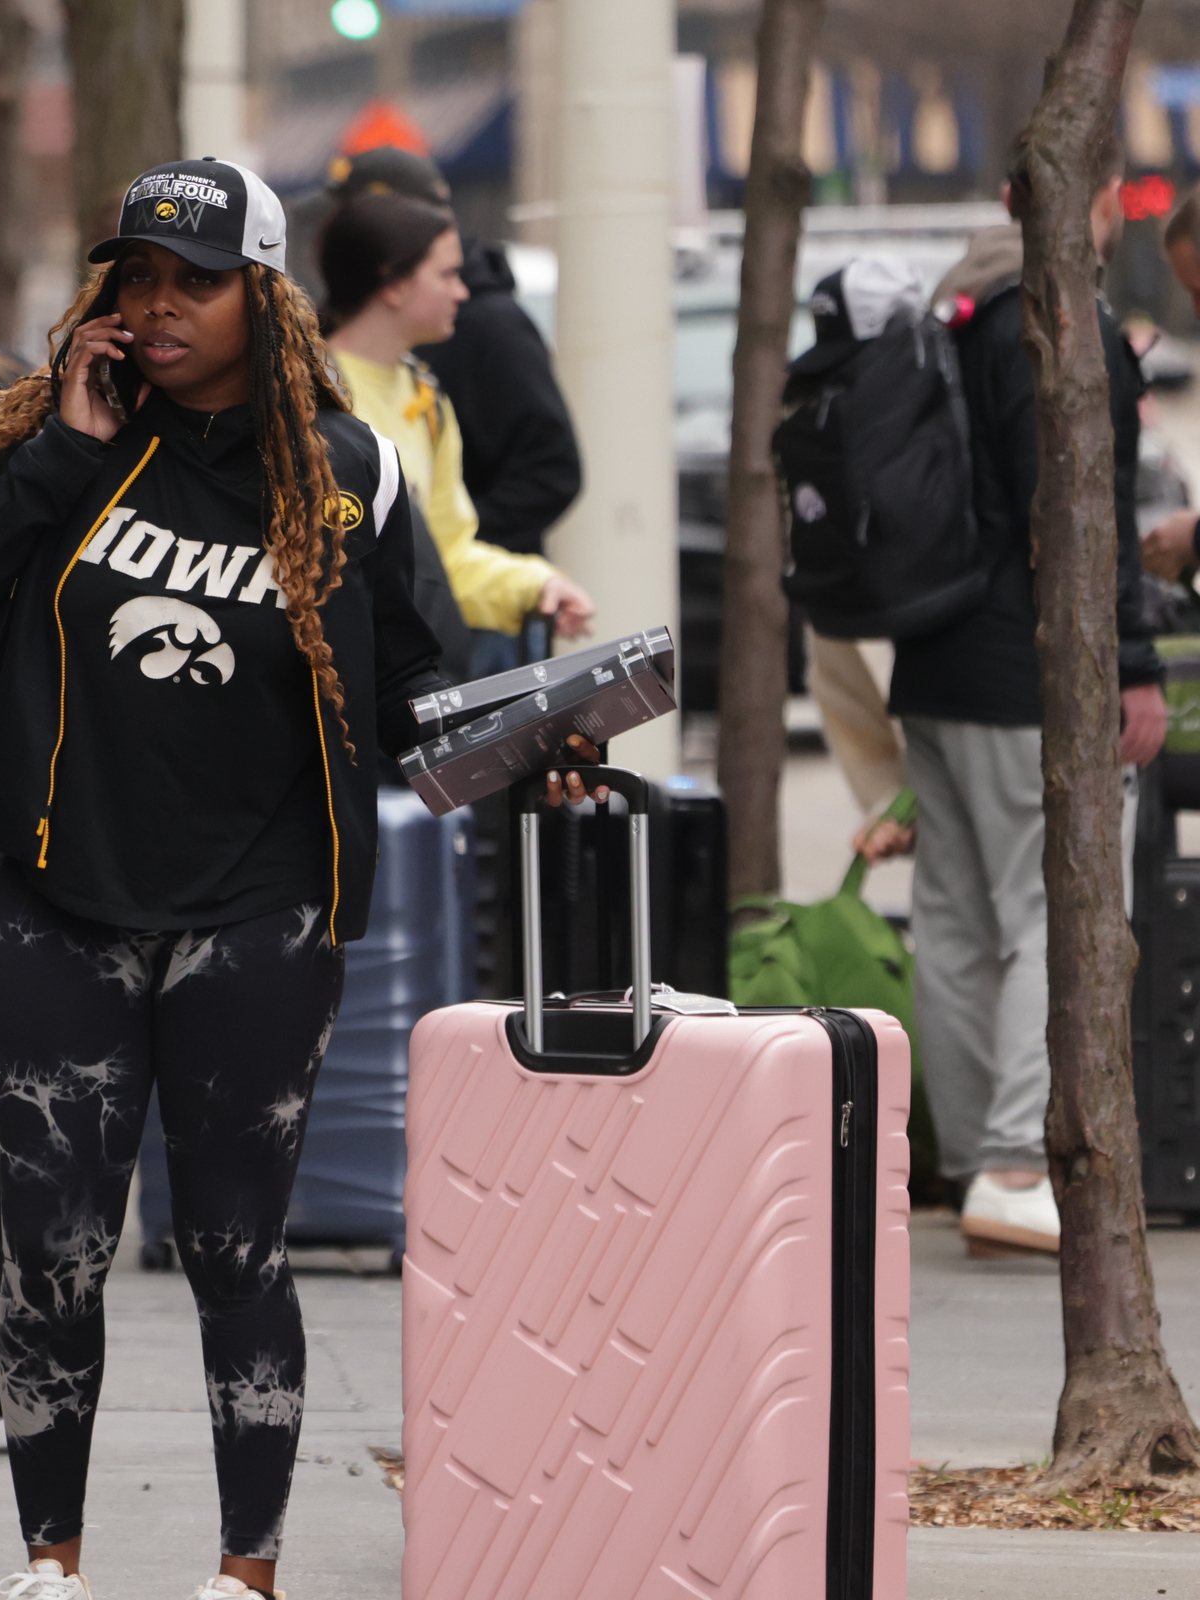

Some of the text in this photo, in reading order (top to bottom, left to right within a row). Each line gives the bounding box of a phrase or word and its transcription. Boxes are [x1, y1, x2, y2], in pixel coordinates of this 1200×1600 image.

[127, 180, 228, 209] FINAL FOUR
[179, 174, 217, 187] WOMEN'S
[78, 506, 289, 609] IOWA
